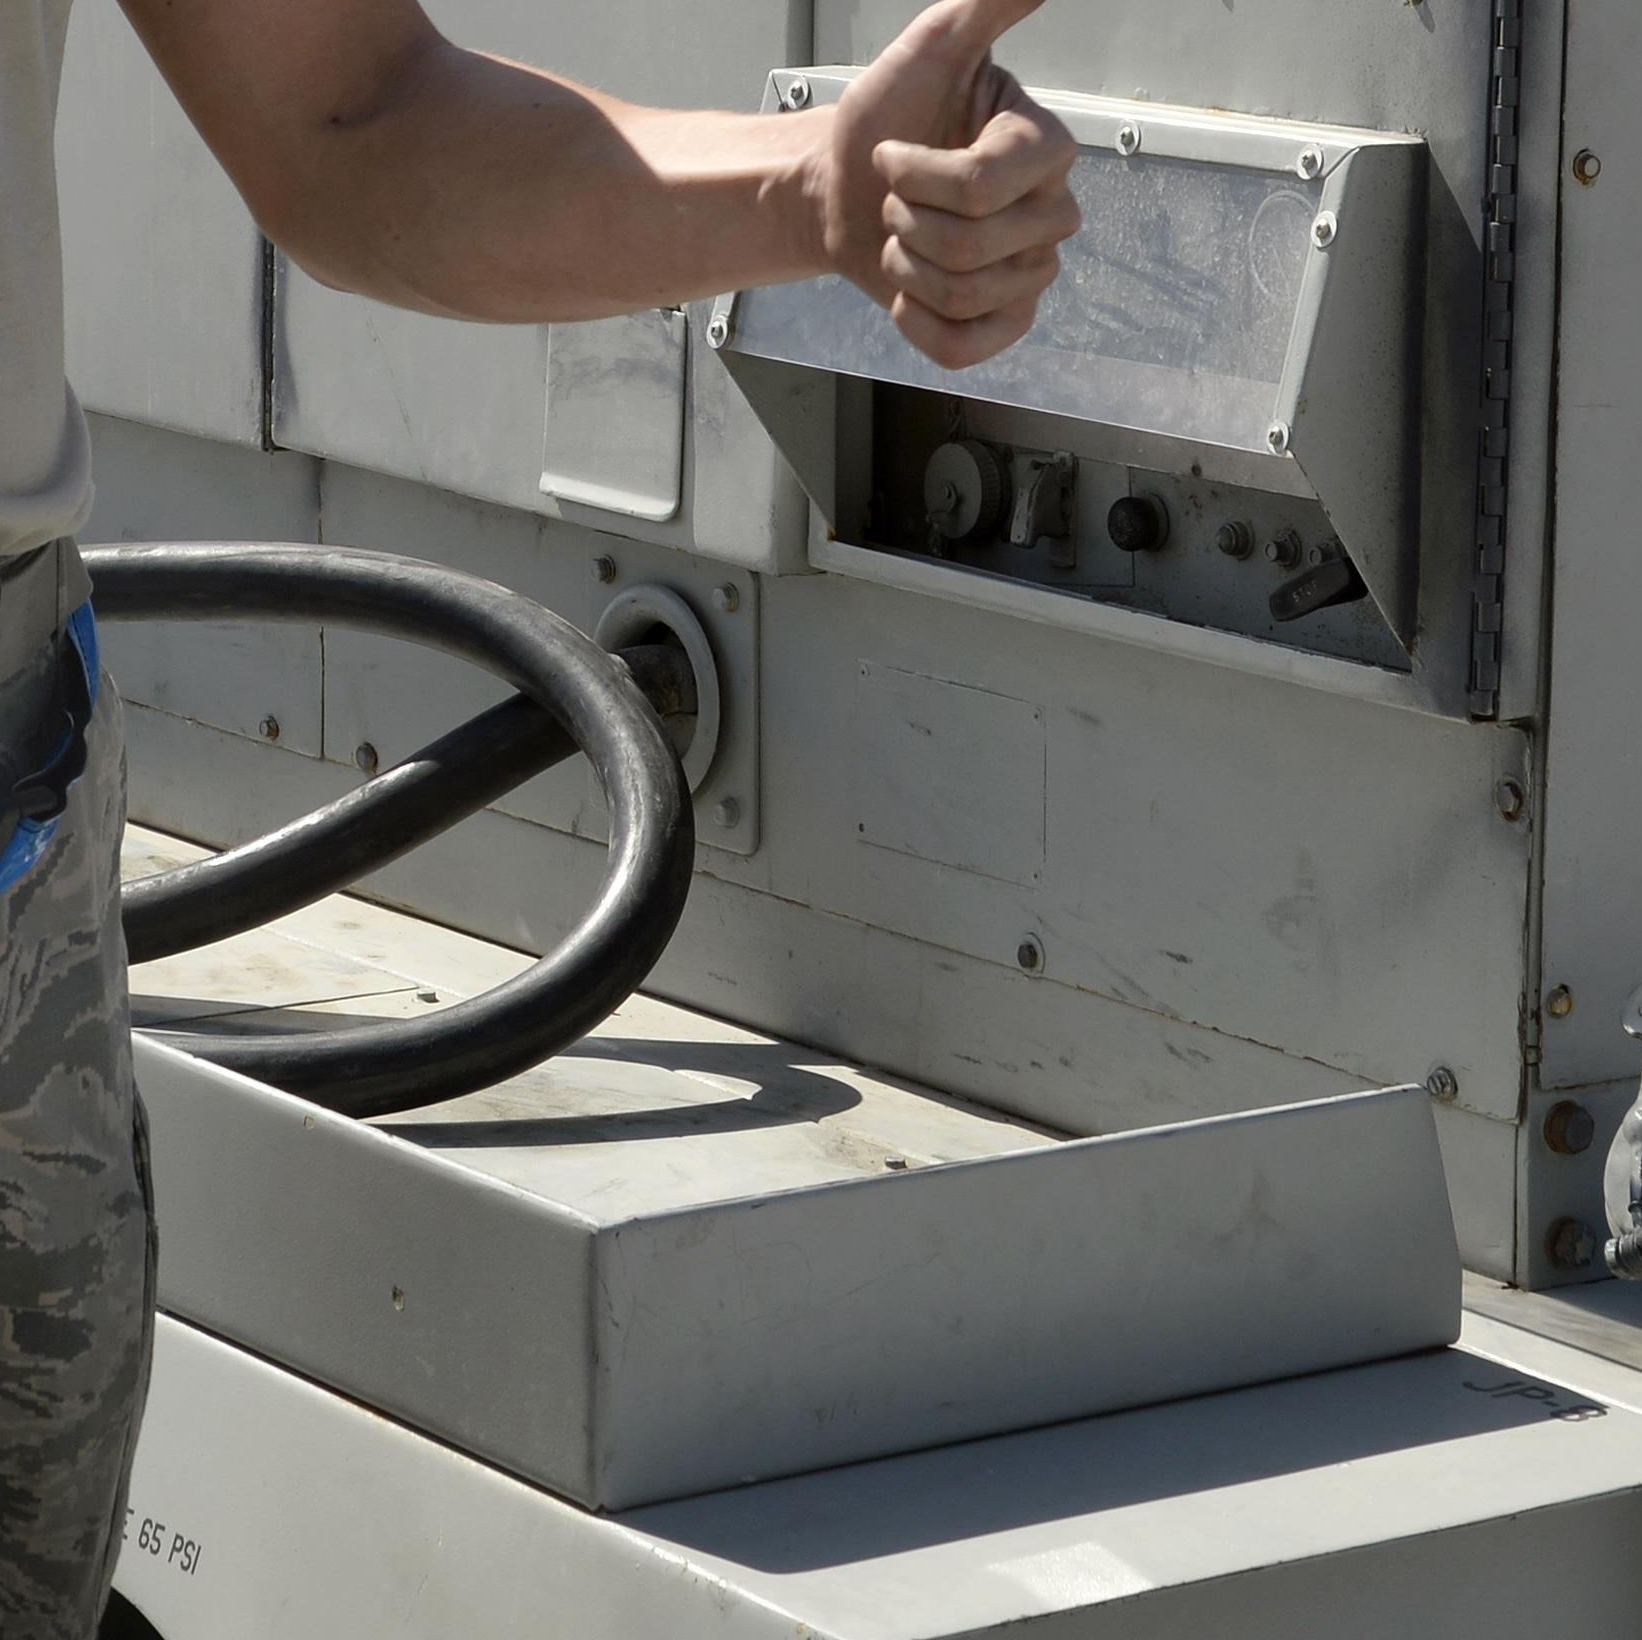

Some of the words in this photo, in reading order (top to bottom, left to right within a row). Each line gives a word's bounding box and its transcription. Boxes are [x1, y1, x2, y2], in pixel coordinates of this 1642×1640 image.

[1462, 1380, 1608, 1422] JP-8
[138, 1518, 166, 1555] 65
[168, 1532, 202, 1576] PSI
